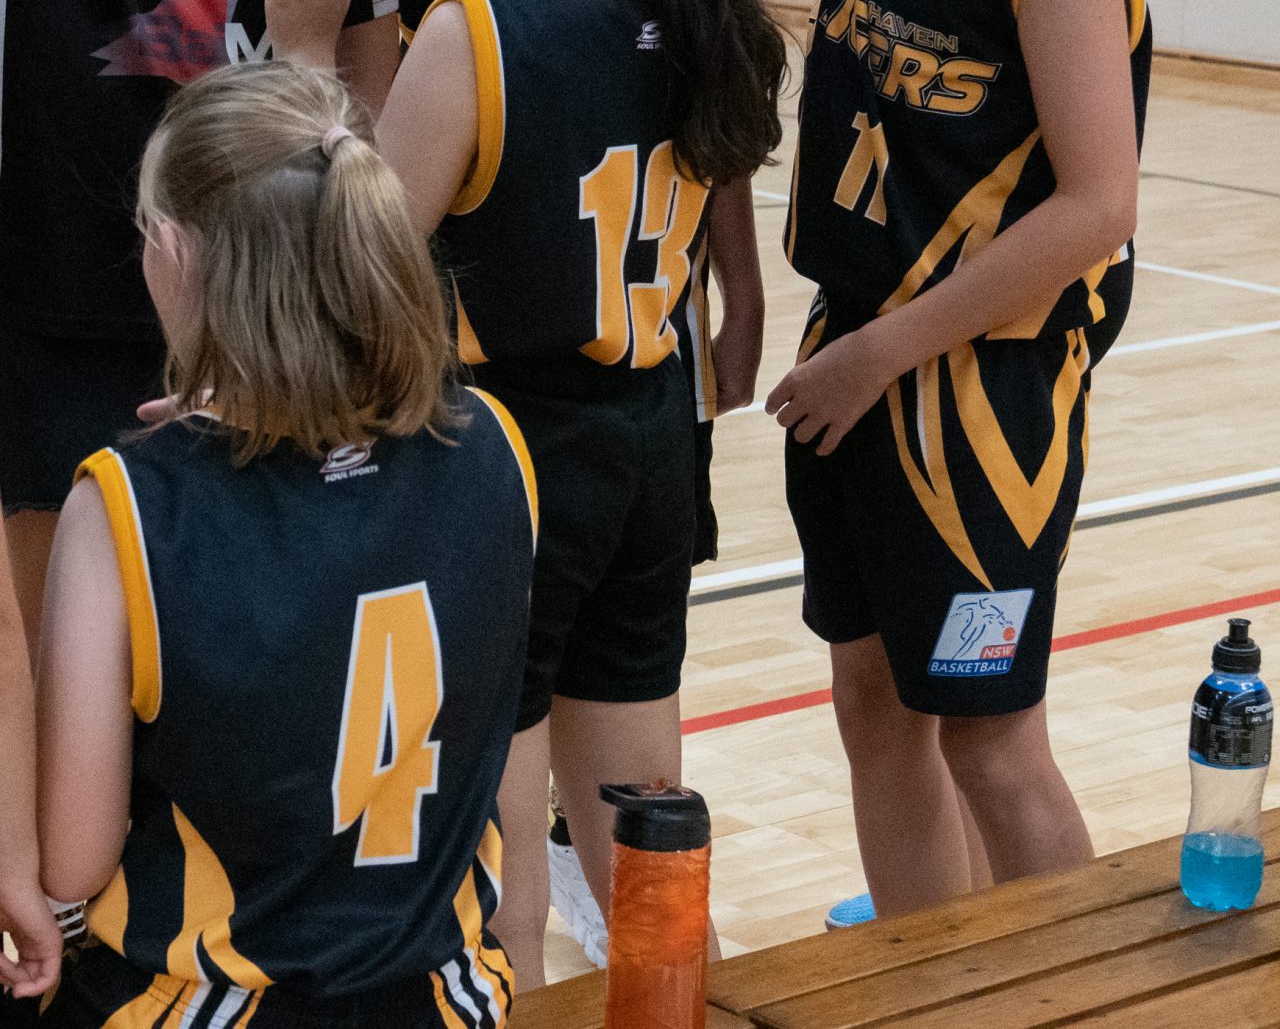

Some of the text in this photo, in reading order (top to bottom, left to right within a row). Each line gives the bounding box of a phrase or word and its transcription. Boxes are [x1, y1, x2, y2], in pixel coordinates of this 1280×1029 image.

[576, 140, 712, 369] 13
[324, 472, 348, 483] SOUL
[983, 646, 1015, 658] NSW
[930, 660, 1008, 673] BASKETBALL
[331, 580, 444, 867] 4
